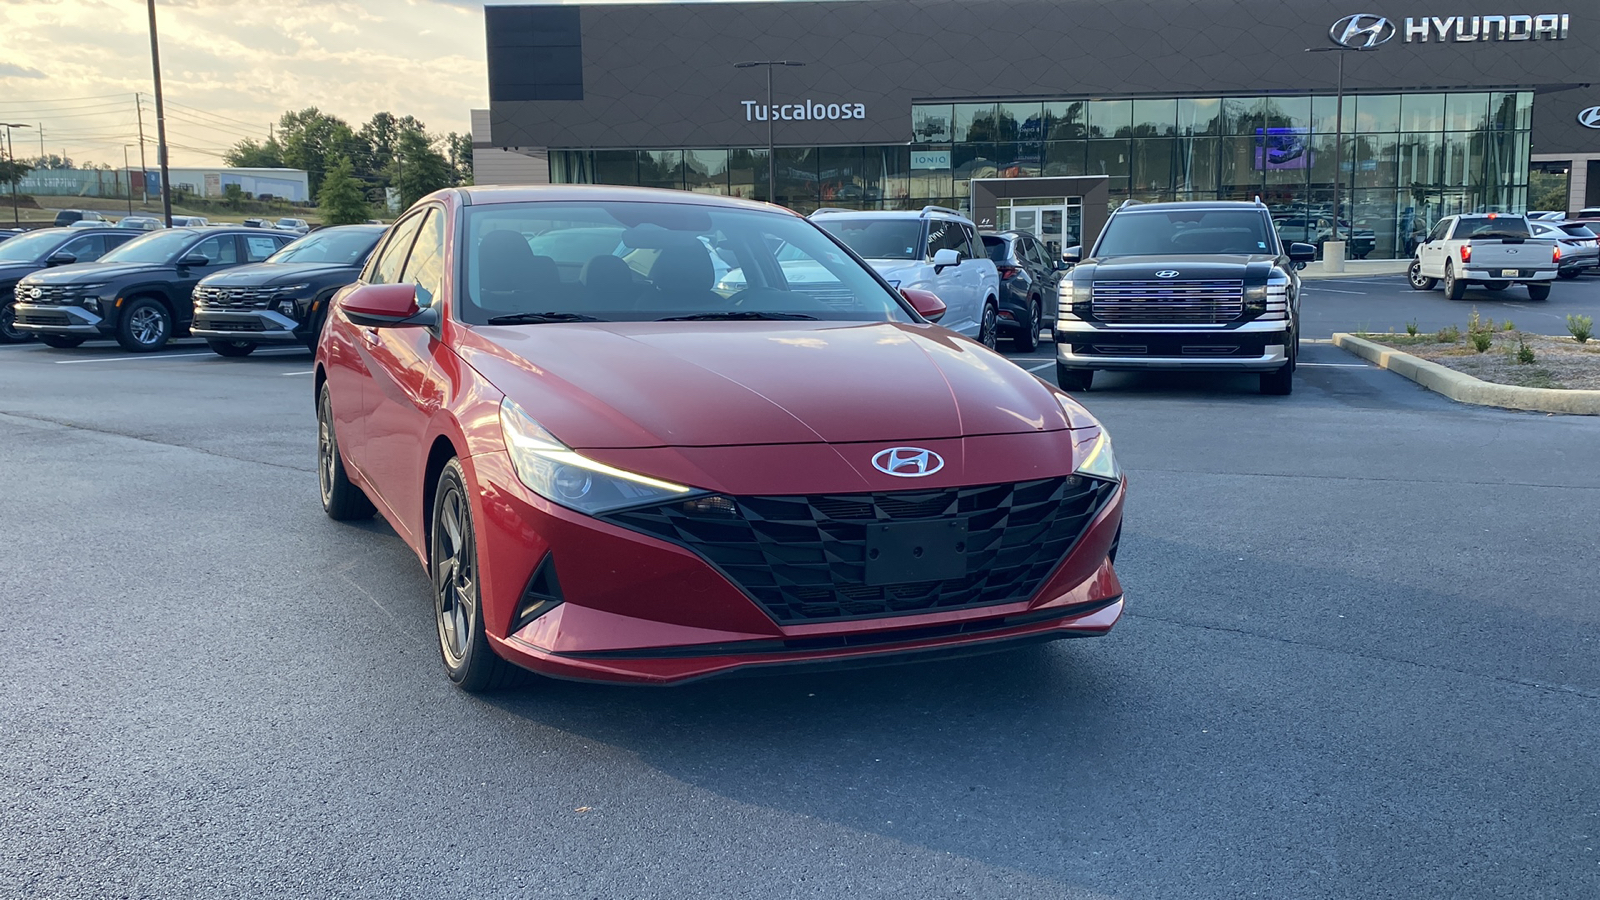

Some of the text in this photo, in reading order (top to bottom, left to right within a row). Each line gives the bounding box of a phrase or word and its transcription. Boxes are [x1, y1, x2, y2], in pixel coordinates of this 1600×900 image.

[1404, 14, 1569, 43] HYUNDAI
[741, 99, 865, 121] Tuscaloosa
[44, 177, 77, 188] SHIPPING
